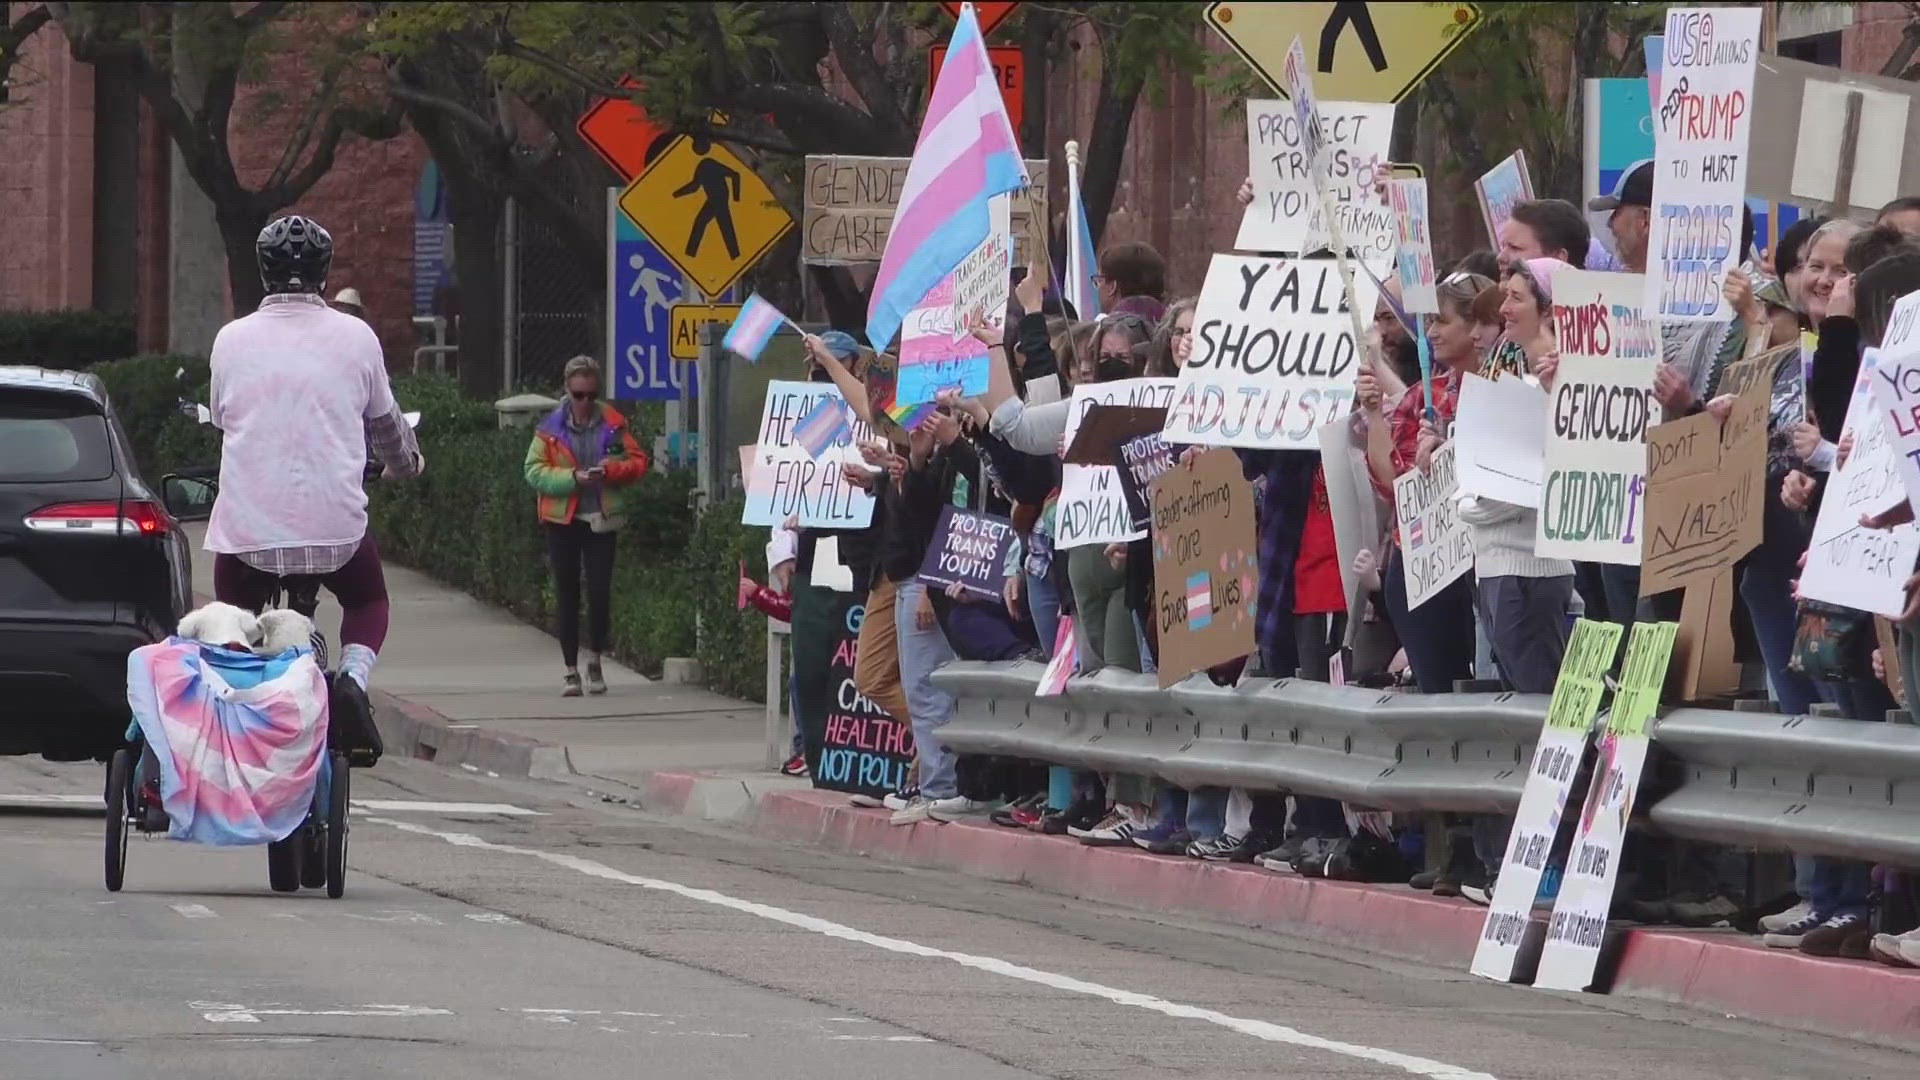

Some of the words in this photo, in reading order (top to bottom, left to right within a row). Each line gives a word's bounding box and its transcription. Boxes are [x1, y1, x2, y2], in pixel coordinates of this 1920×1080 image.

[1667, 12, 1714, 67] USA
[1257, 113, 1369, 148] PROECT
[1660, 75, 1689, 133] PEDO
[1679, 90, 1745, 142] TRUMP
[810, 163, 909, 206] GENDE
[1271, 149, 1350, 181] TRS
[1672, 159, 1689, 179] TO
[1702, 154, 1739, 183] HURT
[1659, 203, 1734, 261] TRANS
[1659, 260, 1723, 317] KIDS
[1186, 319, 1355, 379] SHOULD
[1553, 293, 1611, 357] TRUMP'S
[625, 344, 701, 389] SLO
[1165, 382, 1354, 442] ADJUST
[1554, 382, 1652, 444] GENOCIDE
[769, 460, 816, 518] FOR
[815, 460, 855, 520] ALL
[1090, 469, 1110, 491] IN
[1128, 453, 1176, 486] TRANS
[948, 512, 1010, 542] PROTECT
[1427, 496, 1454, 545] CARE
[1543, 470, 1627, 541] CHILDREN
[938, 551, 992, 581] YOUTH
[945, 532, 998, 561] TRANS
[1411, 545, 1445, 601] SAVES
[1449, 525, 1472, 571] LIVES
[1161, 590, 1188, 634] Saves
[1208, 577, 1240, 615] Lives
[824, 712, 917, 758] HEALTHC
[818, 747, 860, 783] NOT
